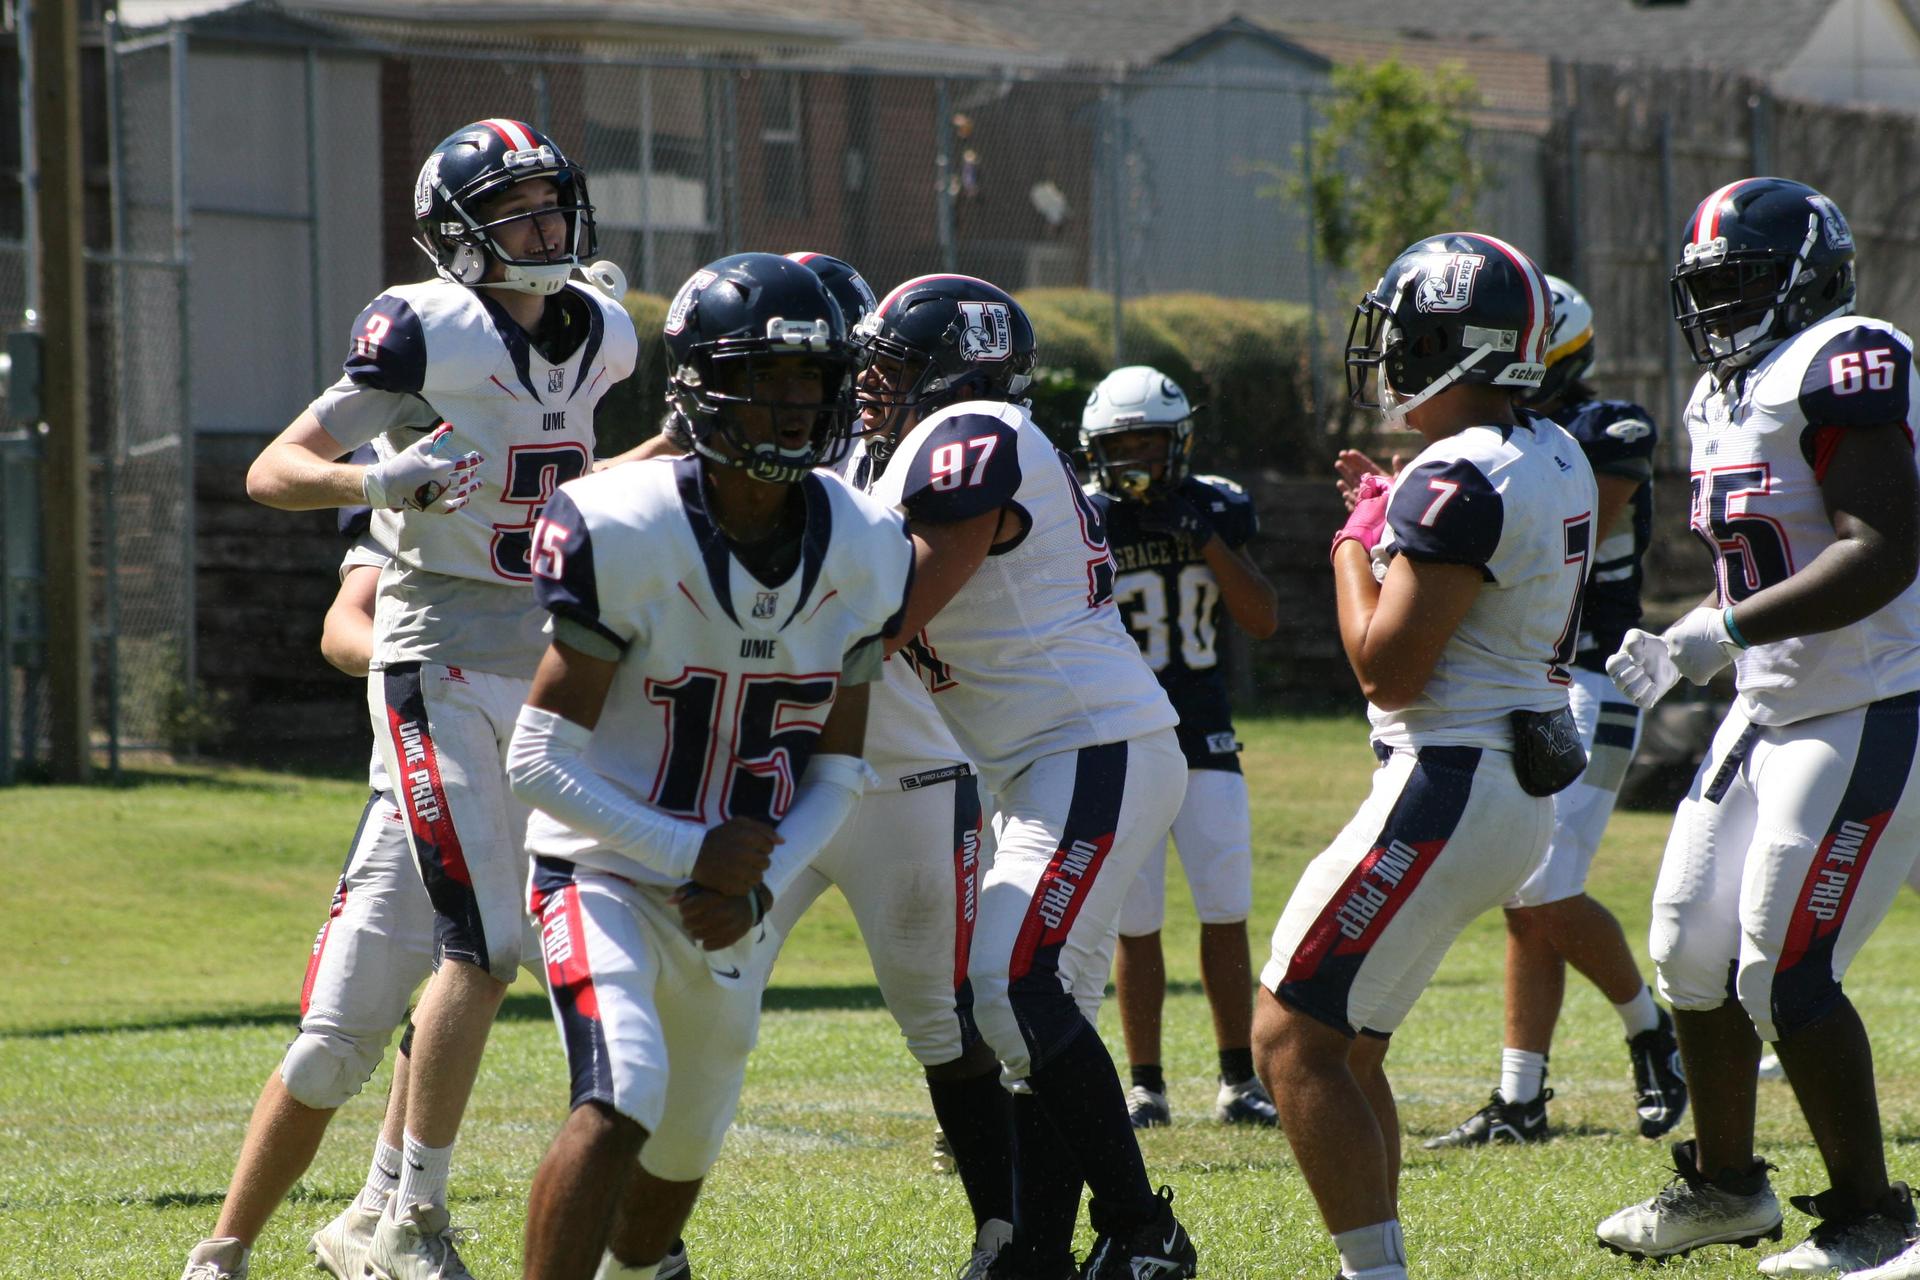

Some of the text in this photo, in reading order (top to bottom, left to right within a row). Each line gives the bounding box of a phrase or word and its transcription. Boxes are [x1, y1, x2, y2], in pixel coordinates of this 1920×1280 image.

[1456, 259, 1473, 301] UME PREP
[993, 308, 1008, 350] UME PREP
[1828, 348, 1896, 396] 65
[542, 411, 567, 431] UME
[929, 433, 999, 493] 97
[1418, 479, 1461, 528] 7
[1112, 564, 1219, 672] 30
[1546, 510, 1591, 686] 7
[739, 638, 777, 659] UME
[398, 720, 444, 824] UME PREP
[644, 666, 841, 830] 15
[963, 828, 978, 923] UME PREP
[1038, 839, 1099, 930] UME PREP
[1335, 838, 1420, 941] UME PREP
[1807, 820, 1872, 921] UME PREP
[543, 912, 573, 965] PREP
